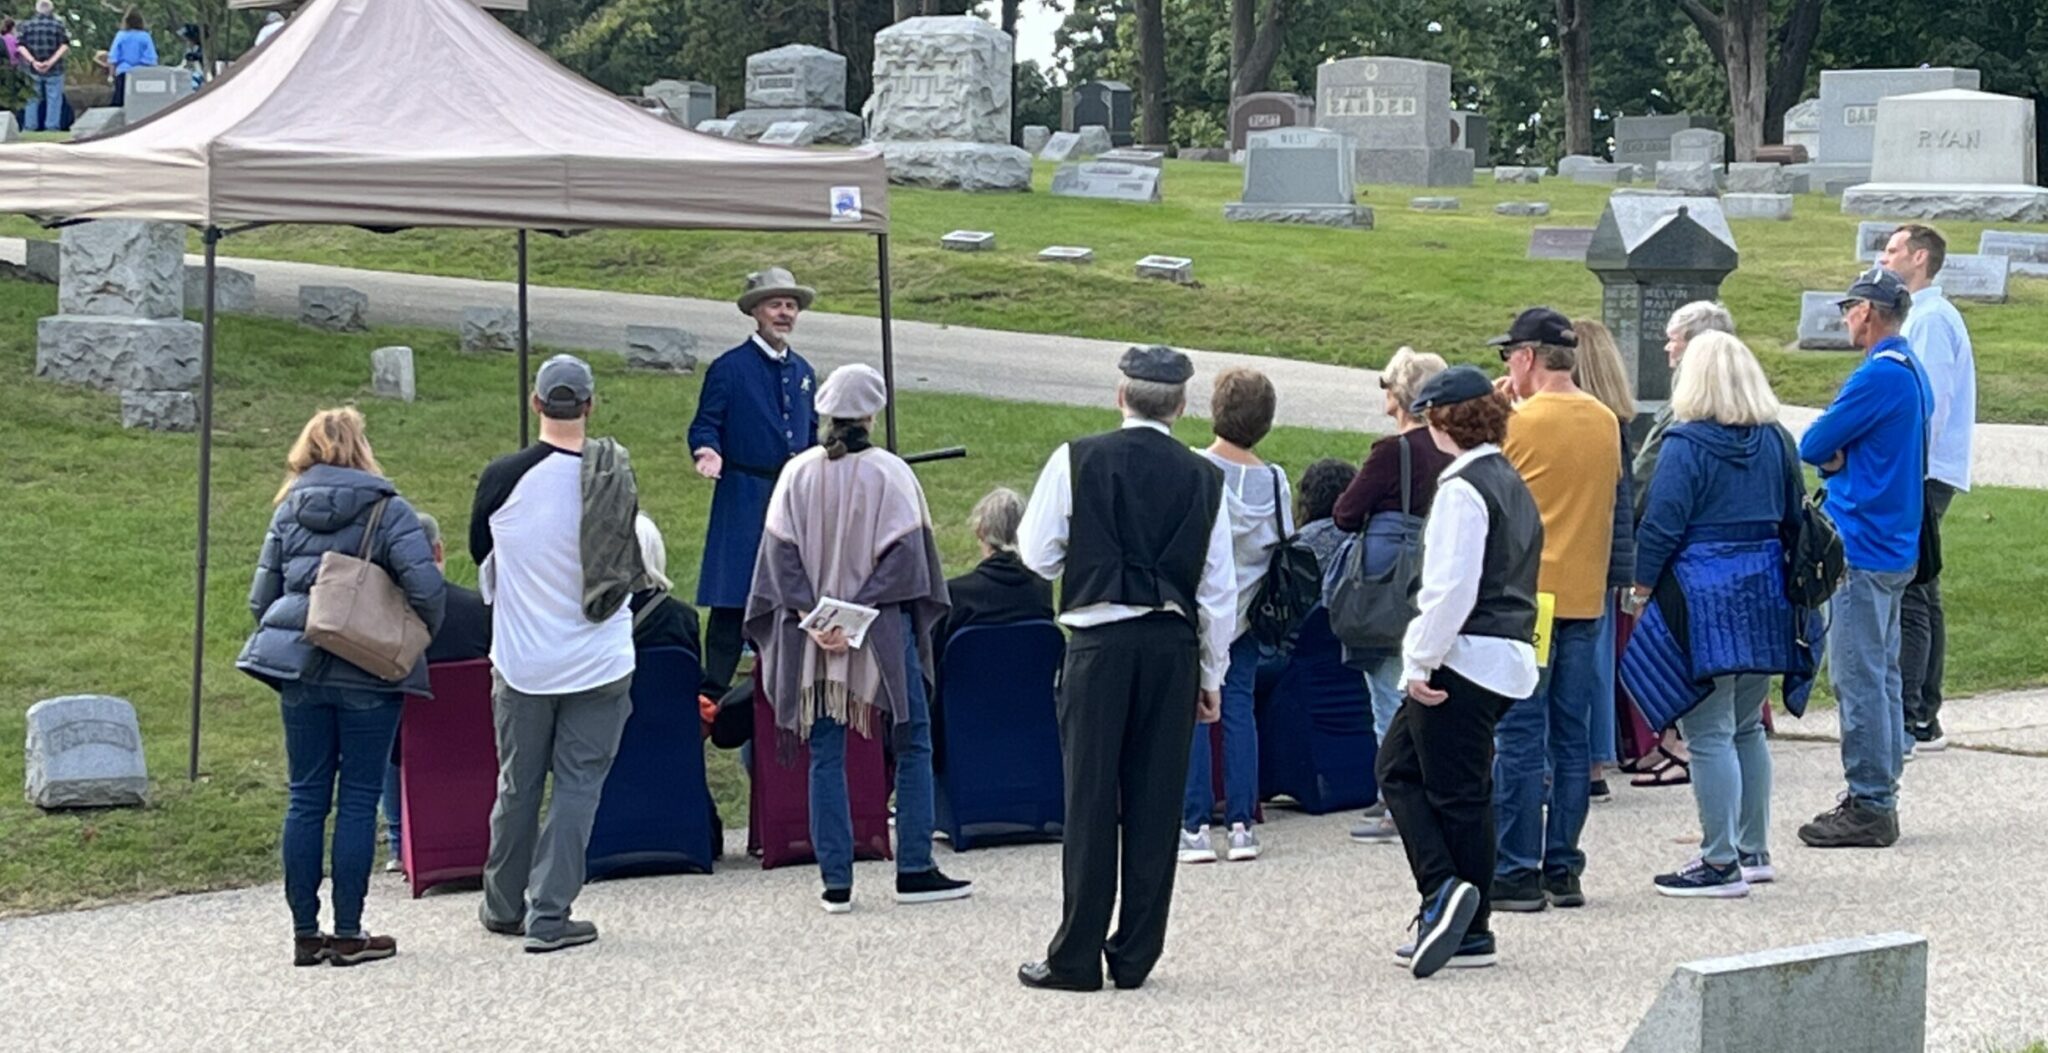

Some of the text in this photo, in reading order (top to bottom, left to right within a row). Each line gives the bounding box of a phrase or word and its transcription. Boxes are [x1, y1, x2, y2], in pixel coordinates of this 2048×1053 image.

[889, 75, 955, 97] TUTTLE
[1328, 99, 1413, 115] ZANDER
[1847, 107, 1878, 124] GAR
[1280, 133, 1309, 144] WEST
[1917, 128, 1982, 150] RYAN
